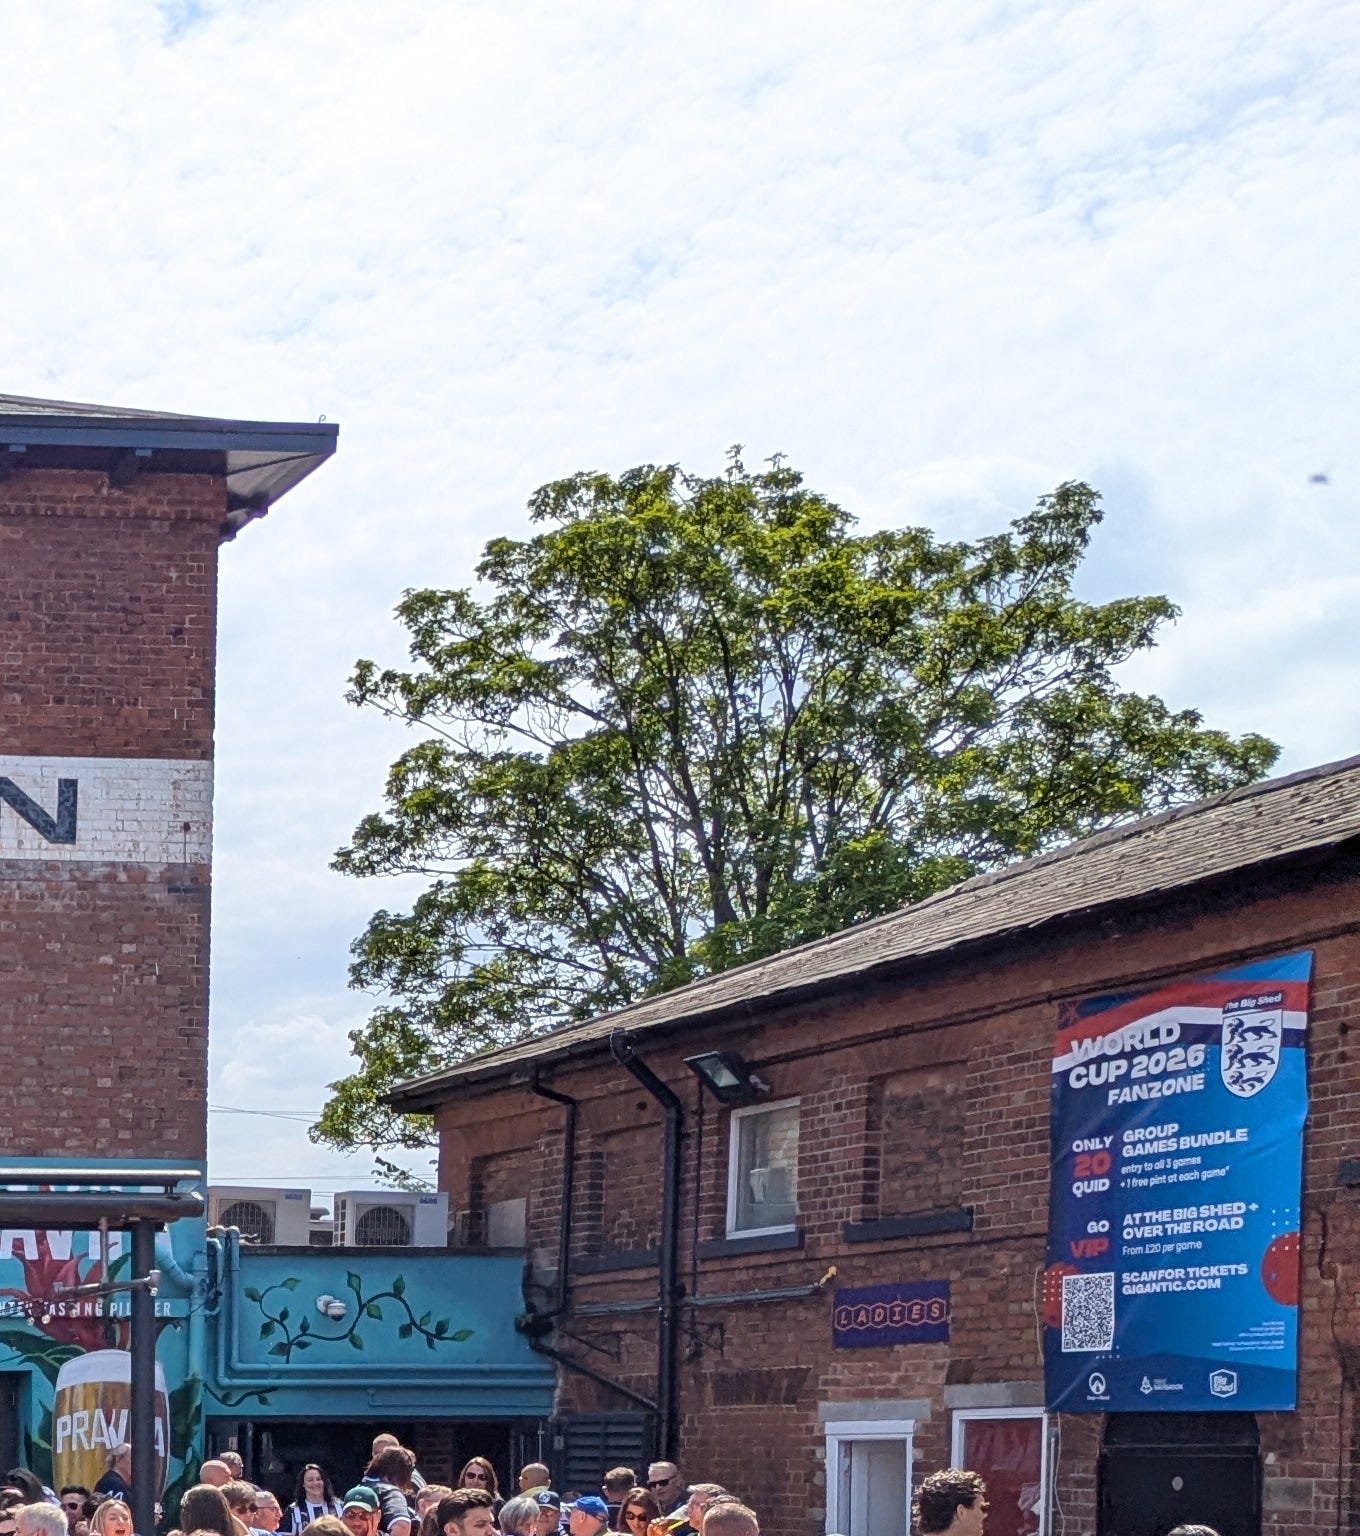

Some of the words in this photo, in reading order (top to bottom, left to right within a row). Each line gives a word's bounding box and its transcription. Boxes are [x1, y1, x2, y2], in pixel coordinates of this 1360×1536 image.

[1240, 997, 1256, 1008] Big
[1257, 993, 1282, 1005] Shed
[1070, 1022, 1180, 1063] WORLD
[1069, 1059, 1128, 1089] CUP
[1131, 1044, 1206, 1079] 2026
[1108, 1073, 1205, 1106] FANZONE
[1122, 1123, 1179, 1143] GROUP
[1122, 1138, 1178, 1158] GAMES
[1180, 1128, 1248, 1149] BUNDLE
[1072, 1135, 1114, 1153] ONLY
[1074, 1151, 1112, 1178] 20
[1121, 1162, 1142, 1176] entry
[1144, 1161, 1153, 1171] to
[1154, 1159, 1165, 1170] all
[1173, 1156, 1202, 1170] games
[1072, 1178, 1110, 1198] QUID
[1131, 1177, 1148, 1188] free
[1149, 1175, 1167, 1188] pint
[1168, 1173, 1178, 1184] at
[1178, 1169, 1199, 1182] each
[1122, 1213, 1142, 1226] AT
[1142, 1209, 1172, 1223] THE
[1173, 1206, 1197, 1221] BIG
[1199, 1202, 1246, 1217] SHED
[1087, 1220, 1109, 1233] GO
[1122, 1224, 1164, 1240] OVER
[1165, 1221, 1192, 1235] THE
[1193, 1217, 1244, 1233] ROAD
[1070, 1237, 1110, 1258] VIP
[1122, 1245, 1144, 1256] From
[1176, 1240, 1202, 1254] game
[1121, 1269, 1158, 1283] SCAN
[1159, 1266, 1185, 1281] FOR
[1186, 1263, 1248, 1278] TICKETS
[1122, 1277, 1221, 1296] GIGANTIC.COM
[44, 1302, 103, 1317] TASING
[110, 1302, 171, 1318] PILER
[840, 1302, 940, 1325] LADIES
[56, 1408, 165, 1458] PRAVA
